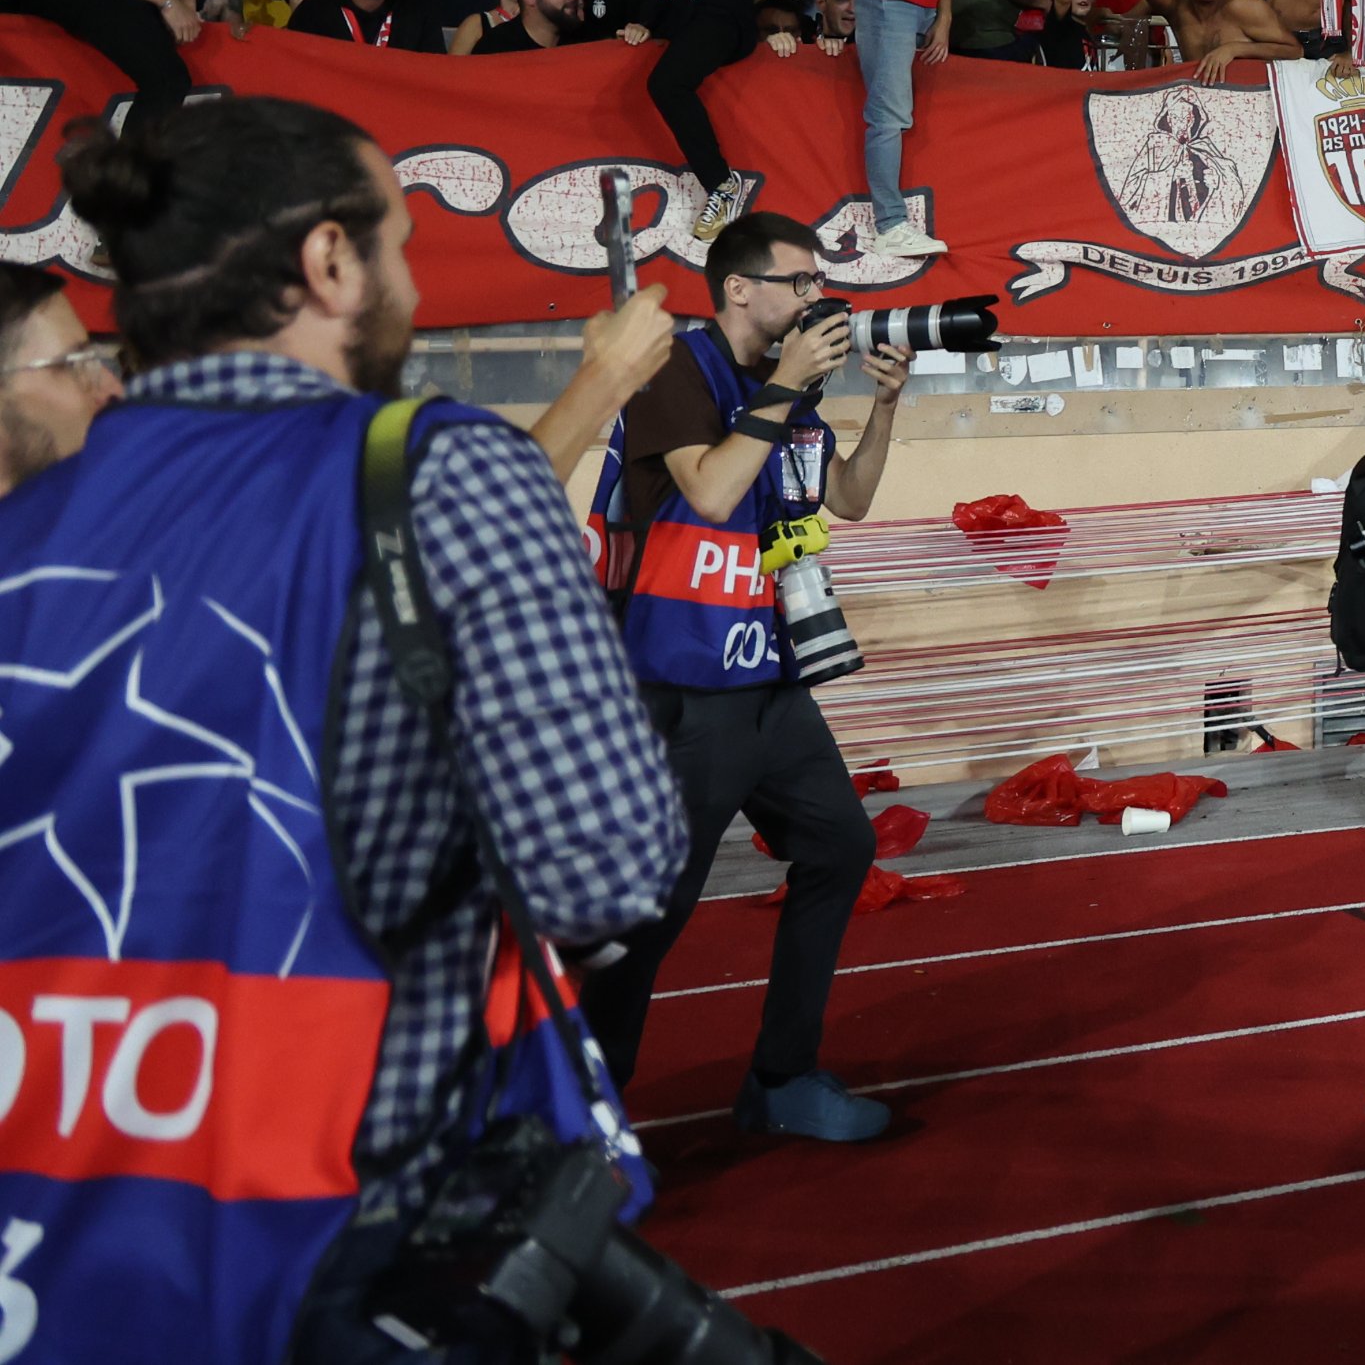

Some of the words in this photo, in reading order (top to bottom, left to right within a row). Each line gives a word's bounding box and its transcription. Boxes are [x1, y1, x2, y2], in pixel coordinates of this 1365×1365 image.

[1322, 137, 1344, 152] AS
[1082, 245, 1213, 285] DEPUIS
[1232, 251, 1305, 280] 1994
